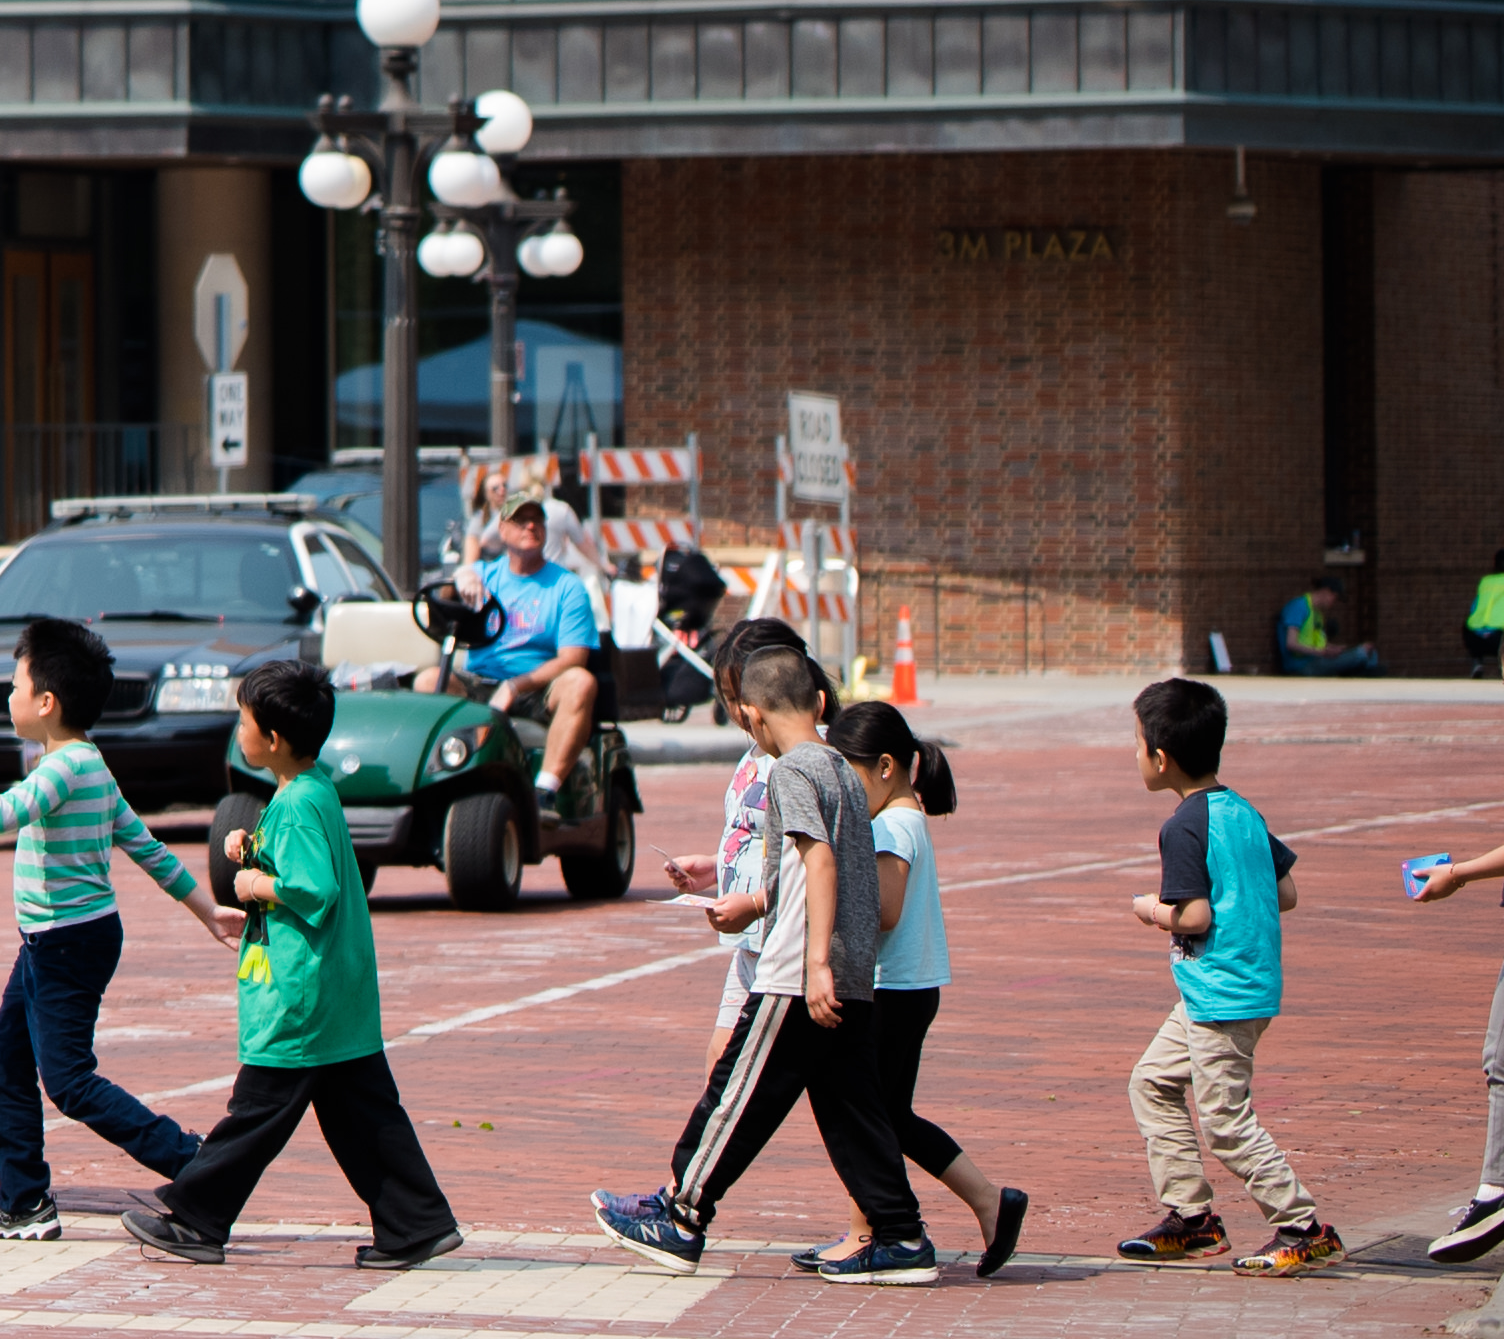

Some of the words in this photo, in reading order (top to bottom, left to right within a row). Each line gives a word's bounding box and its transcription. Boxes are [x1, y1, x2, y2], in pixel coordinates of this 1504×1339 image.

[938, 229, 988, 260] 3M
[1006, 229, 1114, 261] PLAZA
[220, 383, 243, 402] ONE
